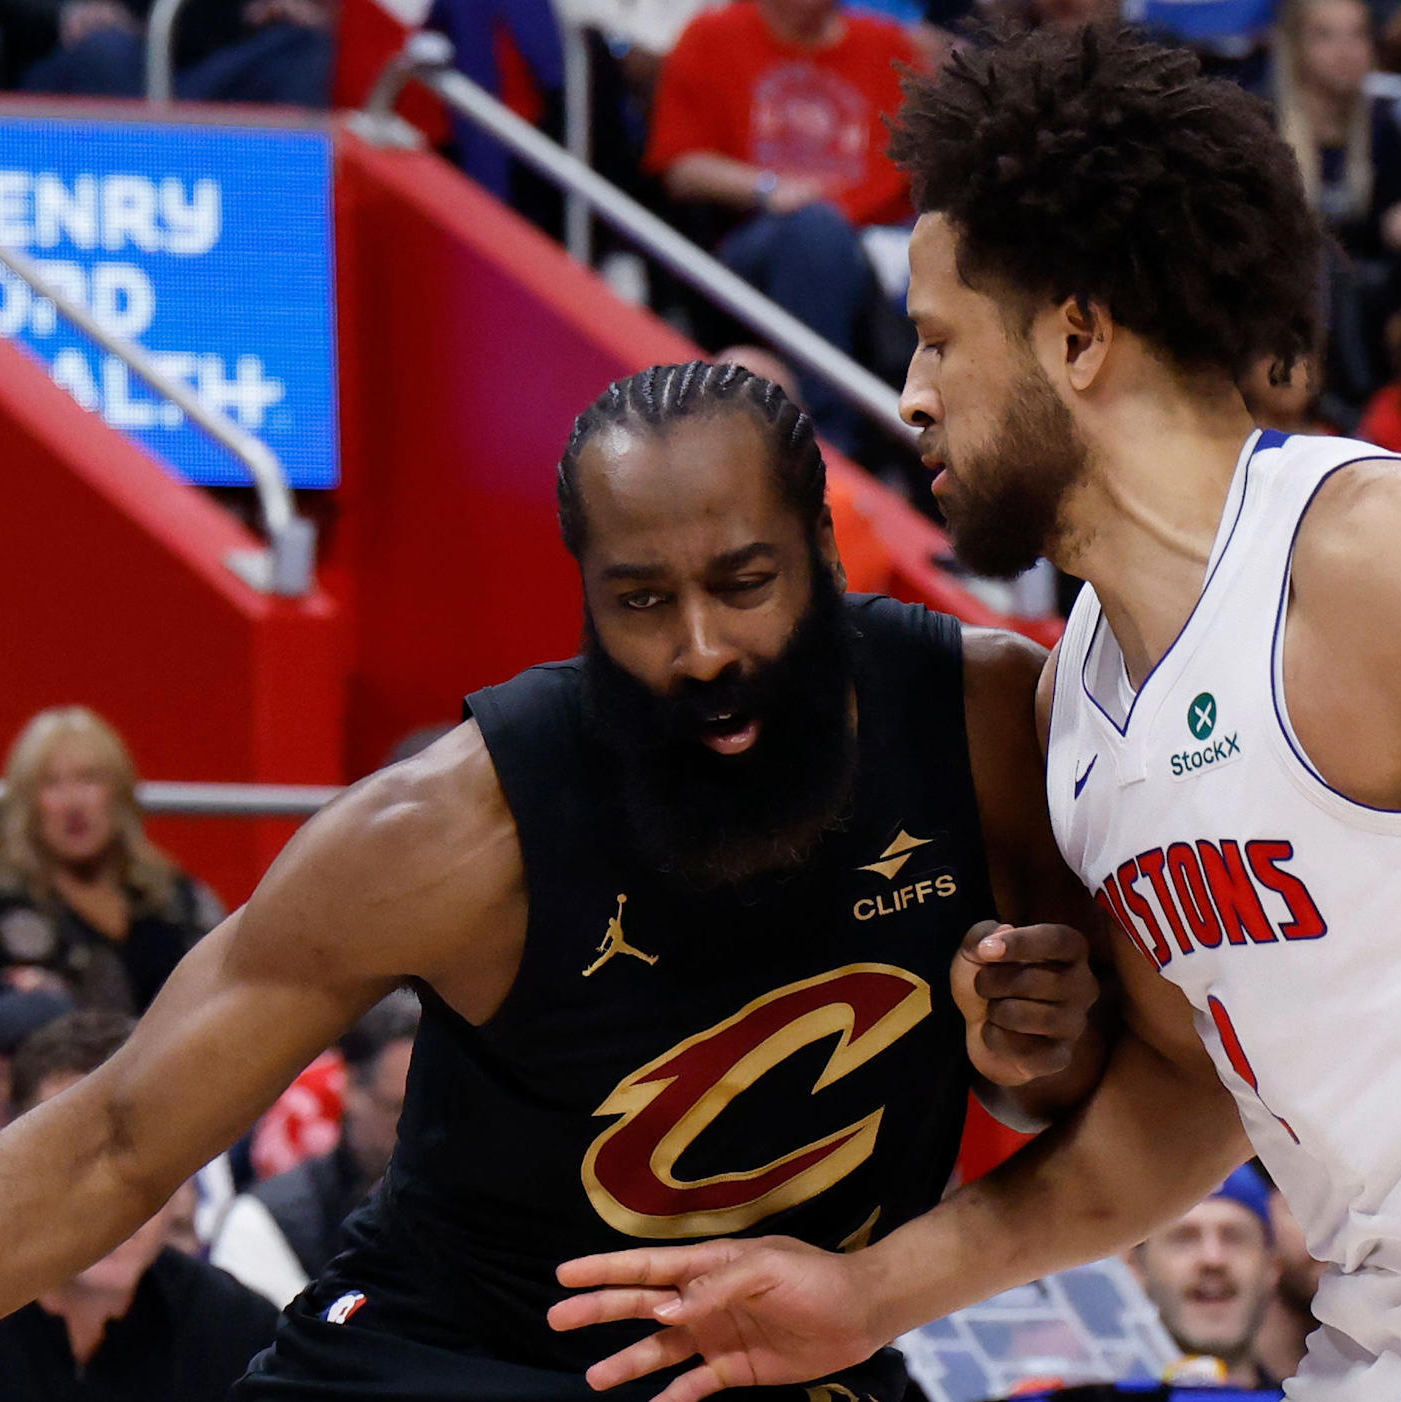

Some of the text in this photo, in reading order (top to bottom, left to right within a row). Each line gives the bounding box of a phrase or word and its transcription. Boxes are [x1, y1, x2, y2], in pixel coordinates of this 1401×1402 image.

[1170, 732, 1241, 776] StockX
[852, 874, 958, 921] CLIFFS
[1095, 839, 1329, 973] ISTONS
